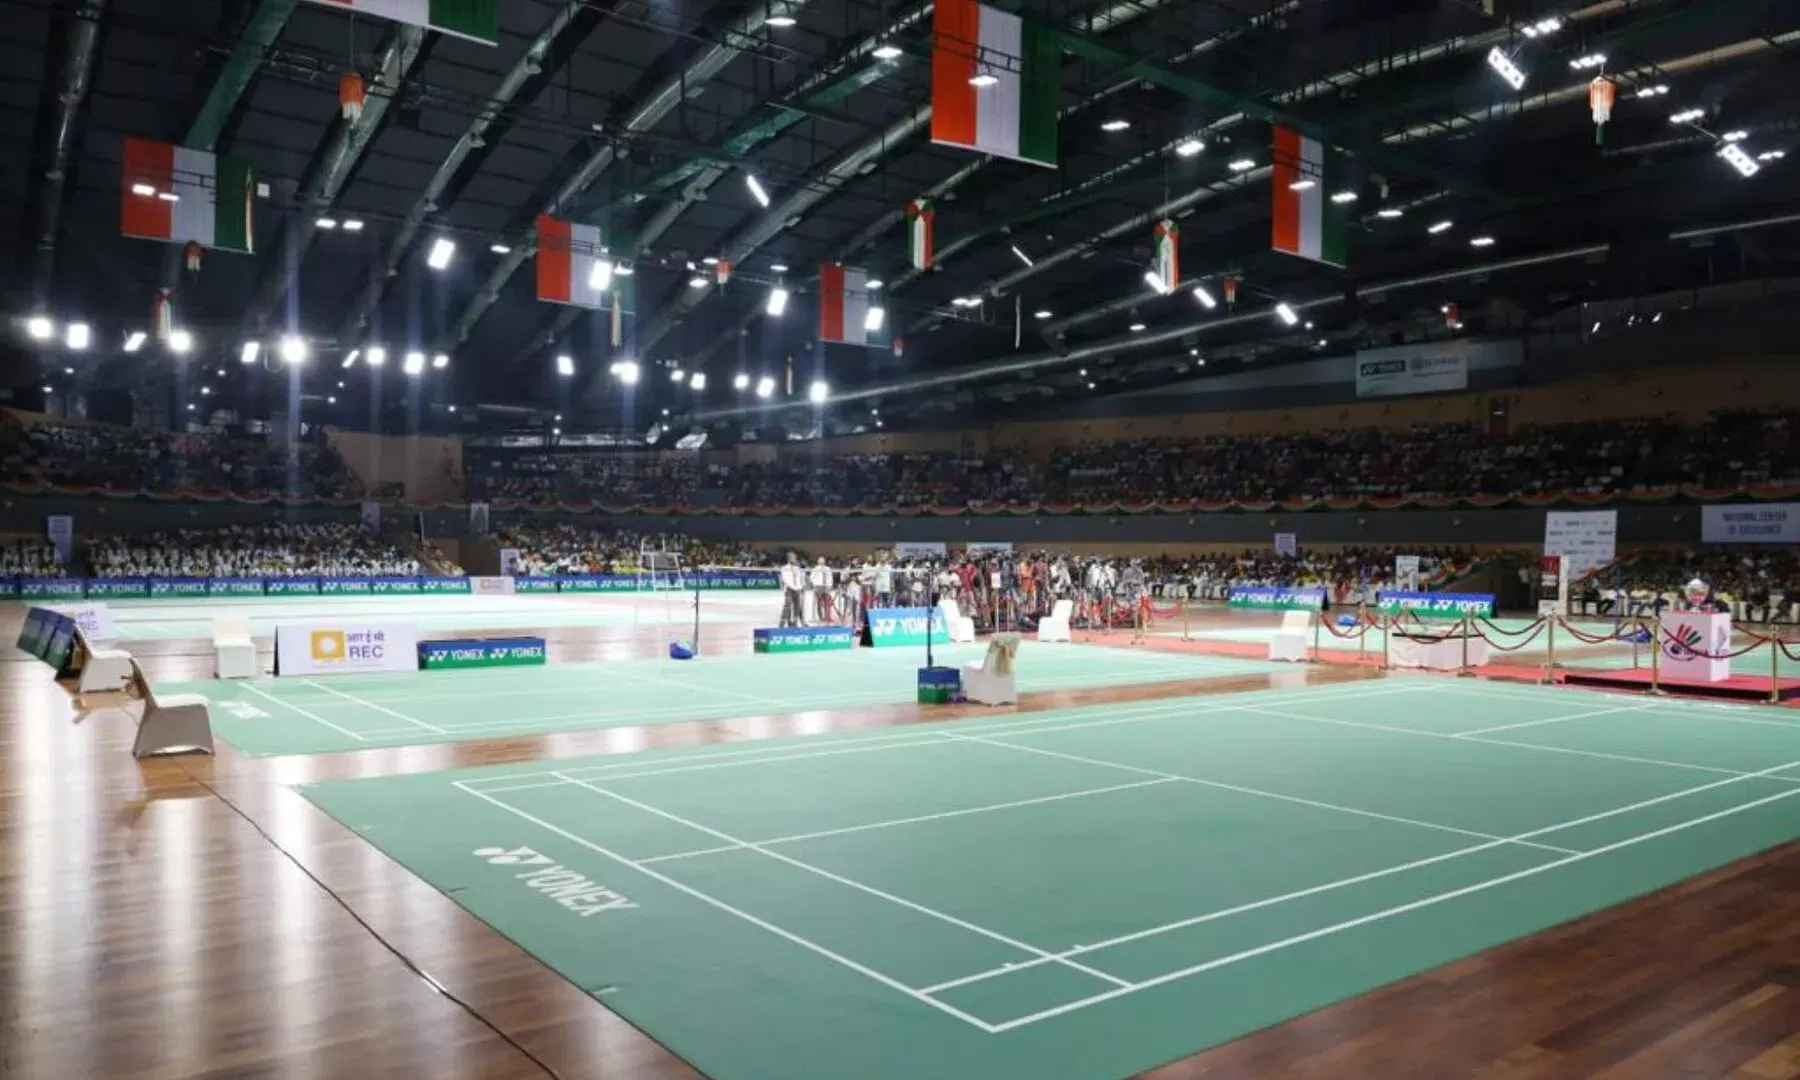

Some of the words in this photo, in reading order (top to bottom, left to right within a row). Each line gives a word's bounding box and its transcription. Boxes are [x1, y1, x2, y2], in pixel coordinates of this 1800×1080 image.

[349, 645, 384, 659] REC
[452, 649, 484, 660] YONEX
[511, 647, 542, 658] YONEX
[515, 864, 640, 917] YONEX
